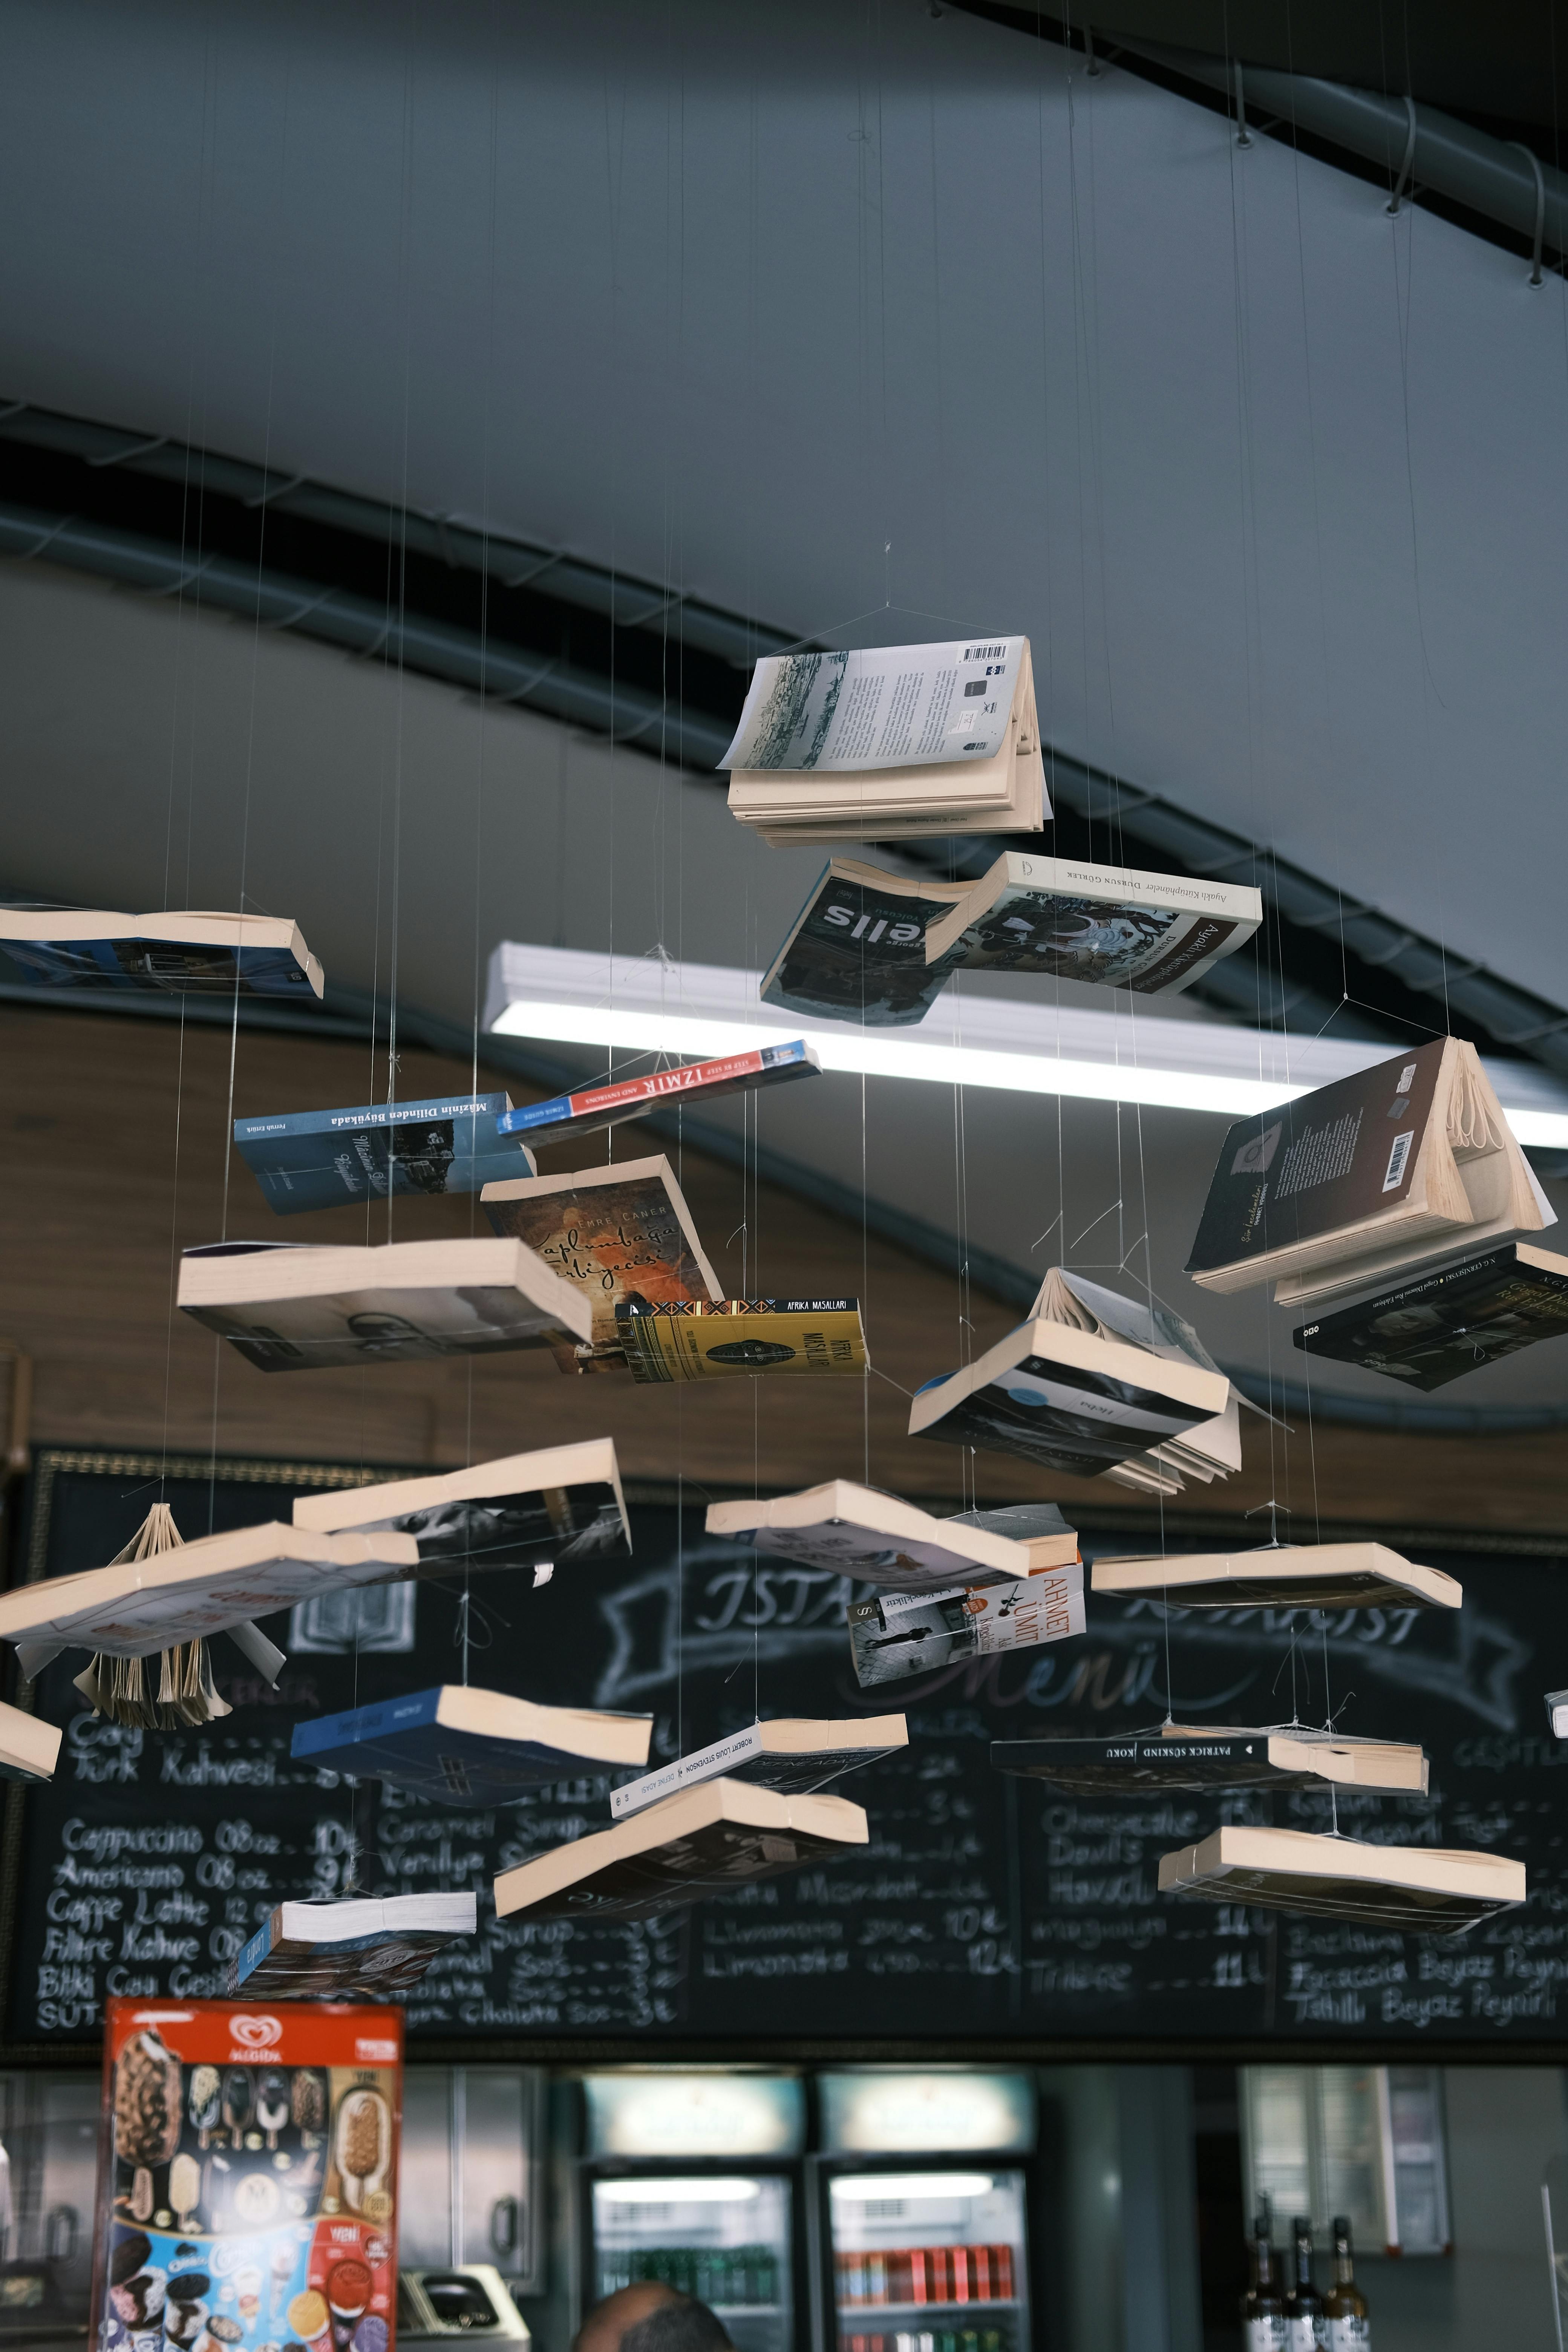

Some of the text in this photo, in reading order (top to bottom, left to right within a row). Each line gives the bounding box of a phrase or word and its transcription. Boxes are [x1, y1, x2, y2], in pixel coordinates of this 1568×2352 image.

[1066, 872, 1227, 903] Ayaklı Kütüphâneler DURSUN GÜRLEK
[823, 905, 926, 945] ells
[875, 907, 920, 923] Yolcusu
[886, 939, 921, 950] george
[1144, 936, 1176, 962] DURSUN
[1134, 924, 1219, 989] Ayaklı Kütüphâneler
[584, 1068, 703, 1105] IZMIR AND ENVIRONS
[246, 1102, 487, 1134] Mâzînin Dilinden Büyükada Ferruh Ertürk
[579, 1207, 667, 1230] EMRE CANER
[1254, 1205, 1263, 1227] AHMET
[1404, 1285, 1423, 1297] Dönemi
[1423, 1278, 1438, 1290] Gogol
[1508, 1282, 1542, 1303] Gogol
[812, 1300, 847, 1310] MASALLARI
[1394, 1292, 1403, 1301] Rus
[1494, 1288, 1517, 1305] Rus
[1044, 1579, 1070, 1636] AHMET
[1014, 1600, 1042, 1643] ÜMİT
[730, 1737, 753, 1752] ROBERT
[1106, 1747, 1230, 1757] PATRICK SÜSKIND KOKU
[684, 1754, 716, 1773] STEVENSON
[809, 1757, 864, 1766] ADASI
[640, 1782, 657, 1793] ADASI
[247, 1932, 265, 1964] Londra
